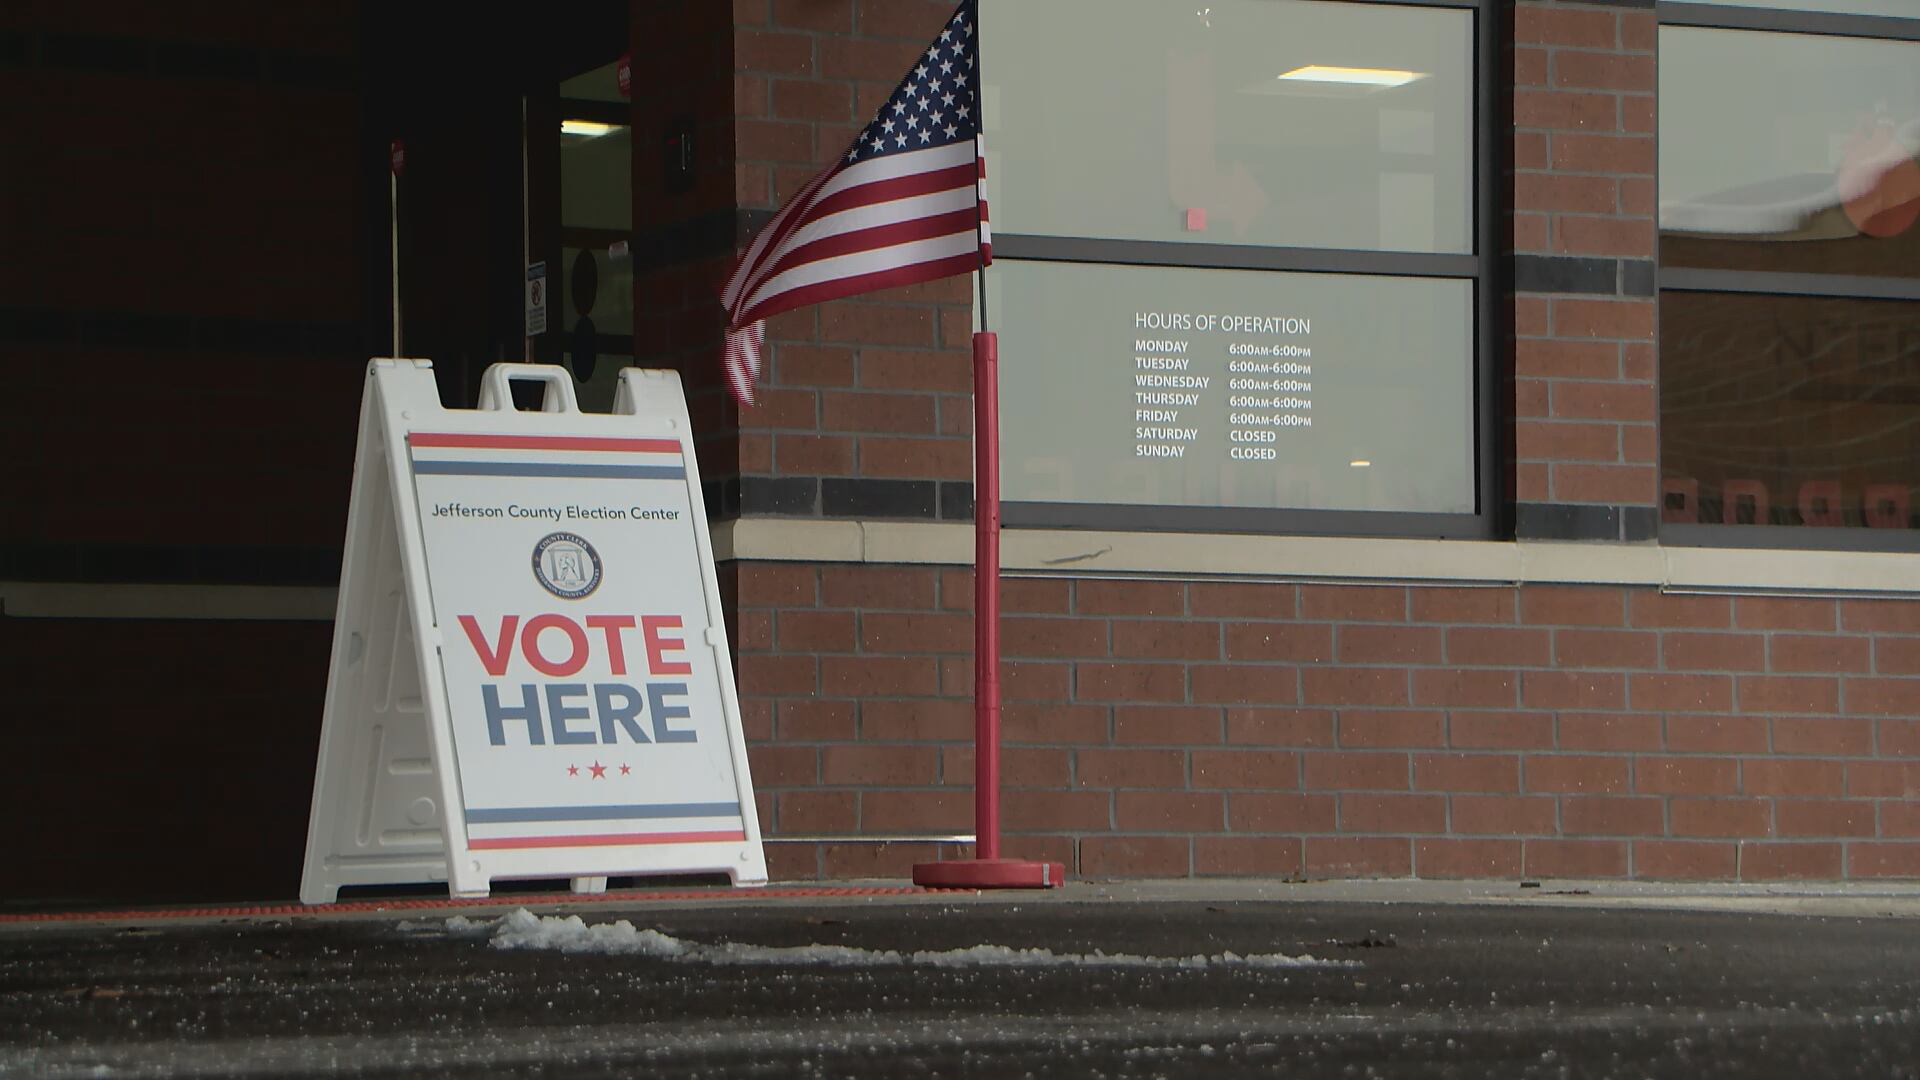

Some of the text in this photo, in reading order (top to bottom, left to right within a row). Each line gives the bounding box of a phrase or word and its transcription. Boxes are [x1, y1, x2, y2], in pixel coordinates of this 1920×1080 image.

[1135, 312, 1311, 334] HOURS OF OPERATION
[1135, 340, 1188, 353] MONDAY
[1136, 357, 1189, 370] TUESDAY
[1136, 375, 1209, 388] WEDNESDAY
[1136, 392, 1199, 405] THURSDAY
[1136, 410, 1178, 422] FRIDAY
[1136, 427, 1276, 442] SATURDAY CLOSED
[1136, 445, 1276, 460] SUNDAY CLOSED
[432, 504, 679, 522] Jefferson County Election Center
[457, 614, 692, 677] VOTE
[481, 683, 698, 746] HERE
